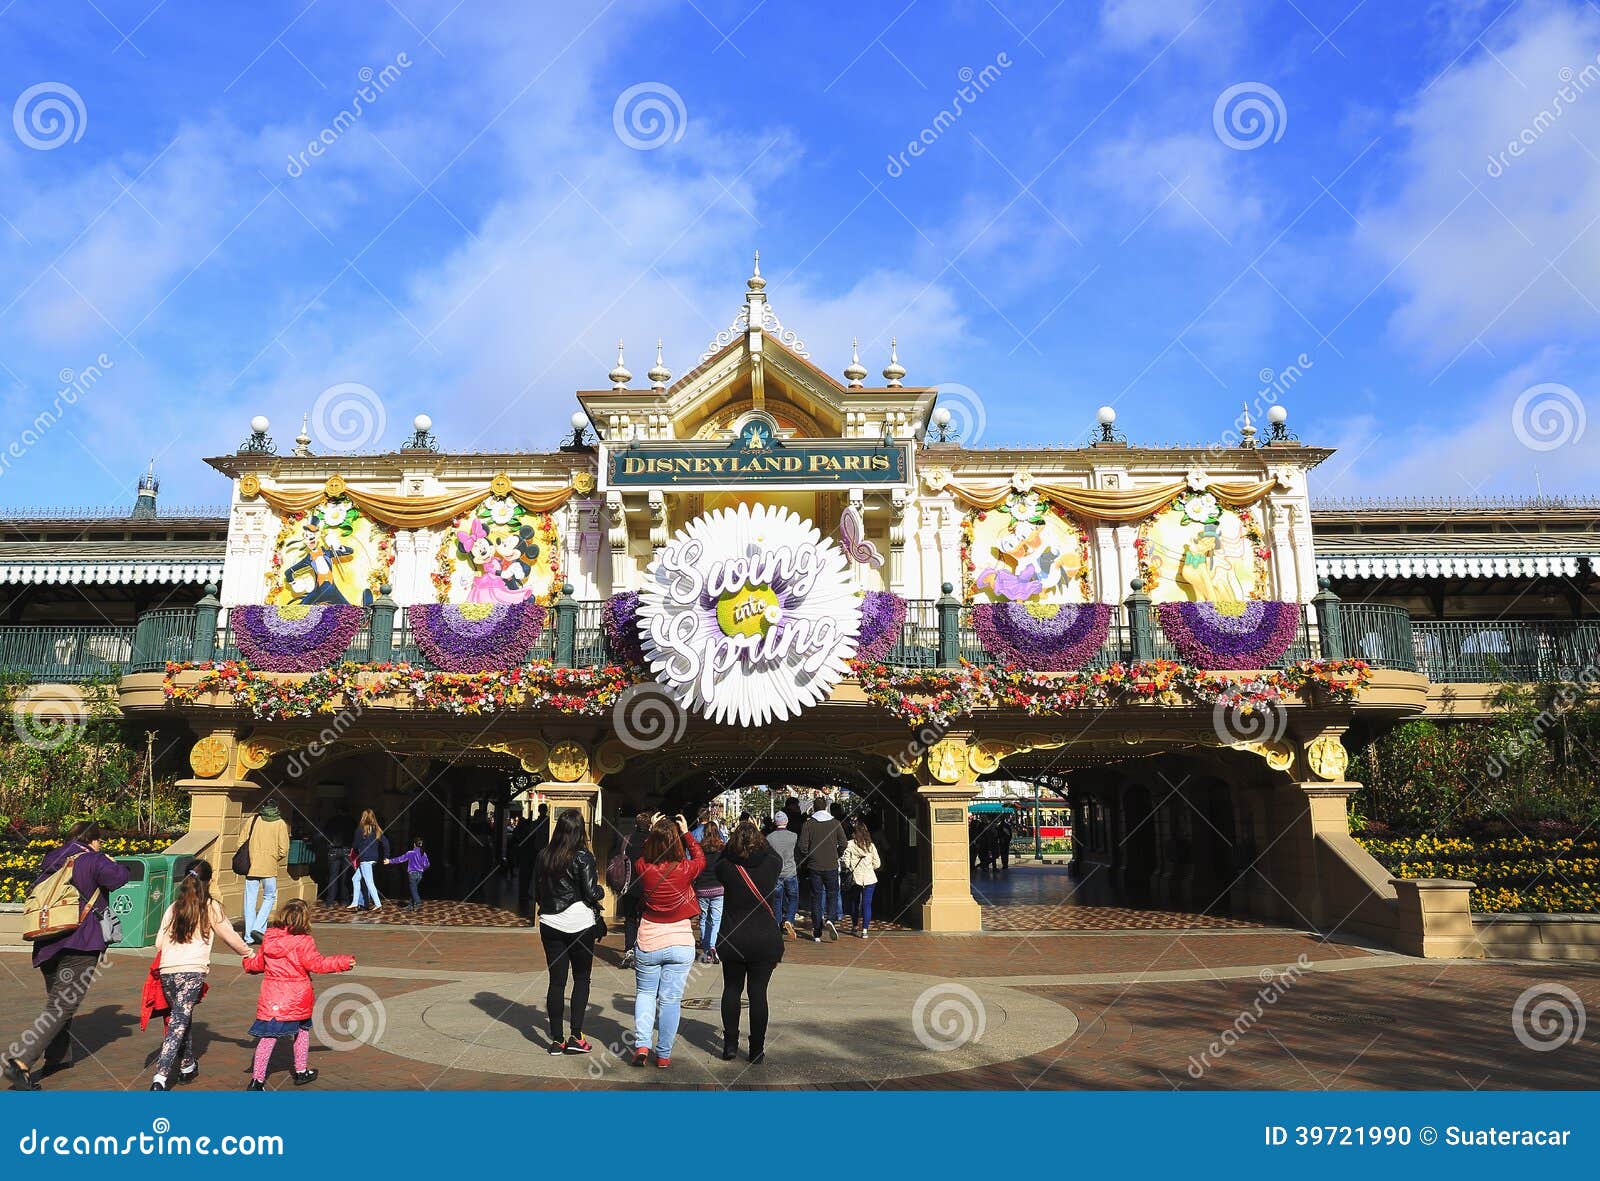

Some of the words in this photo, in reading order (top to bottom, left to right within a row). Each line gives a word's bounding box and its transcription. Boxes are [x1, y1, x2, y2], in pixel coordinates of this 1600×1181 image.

[623, 456, 802, 476] DISNEYLAND
[809, 453, 891, 472] PARIS
[662, 538, 826, 606] Swing
[734, 594, 767, 623] into
[650, 609, 845, 704] Spring
